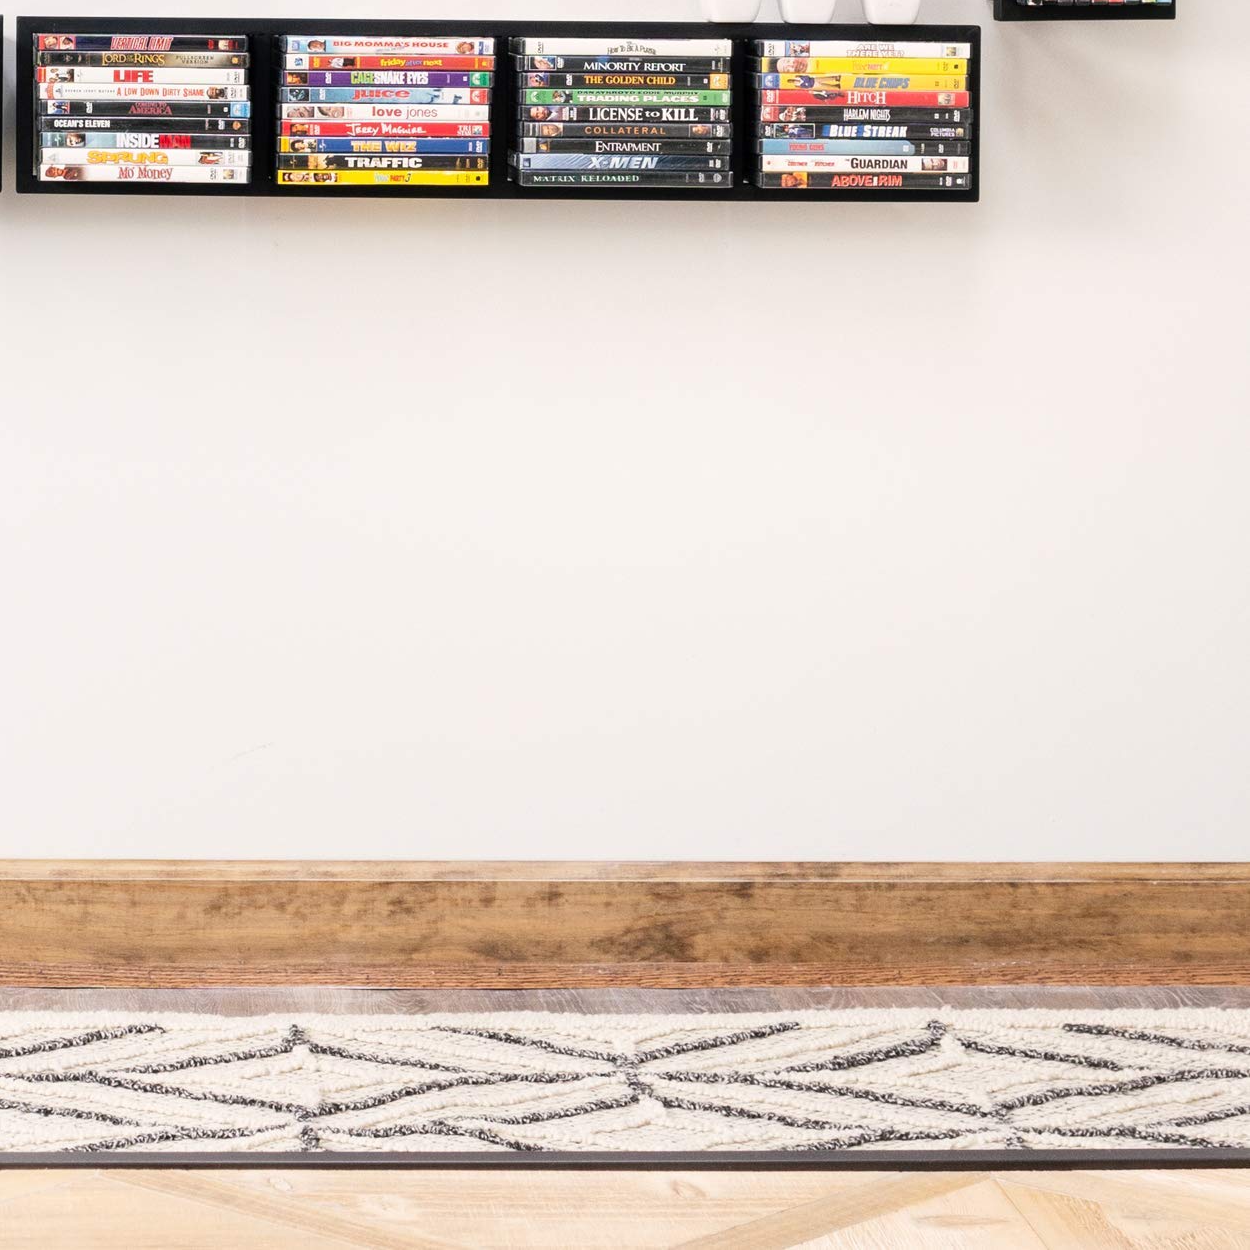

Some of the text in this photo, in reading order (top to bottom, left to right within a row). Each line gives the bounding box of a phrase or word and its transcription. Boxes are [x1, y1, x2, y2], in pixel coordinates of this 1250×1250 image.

[102, 54, 165, 65] LORD RINGS
[583, 62, 686, 71] MINORITY REPORT
[113, 70, 153, 83] LIFE
[584, 76, 676, 84] THE GOLDEN CHILD
[853, 77, 910, 88] BLUE CHIPS
[352, 89, 411, 100] juice
[847, 92, 886, 104] HITCH
[128, 107, 173, 115] AMERICA
[372, 106, 438, 117] love jones
[589, 108, 643, 120] LICENSE
[662, 108, 699, 121] KILL
[54, 120, 110, 128] OCEAN'S ELEVEN
[830, 126, 907, 138] BLUE STREAK
[116, 133, 191, 148] INSIDE MAN
[351, 141, 417, 152] THE WIZ
[595, 141, 662, 152] ENTRAPMENT
[87, 151, 169, 164] SPRUNG
[345, 157, 422, 168] TRAFFIC
[589, 157, 659, 169] X-MEN
[851, 157, 908, 169] GUARDIAN
[831, 175, 902, 187] ABOVE RIM
